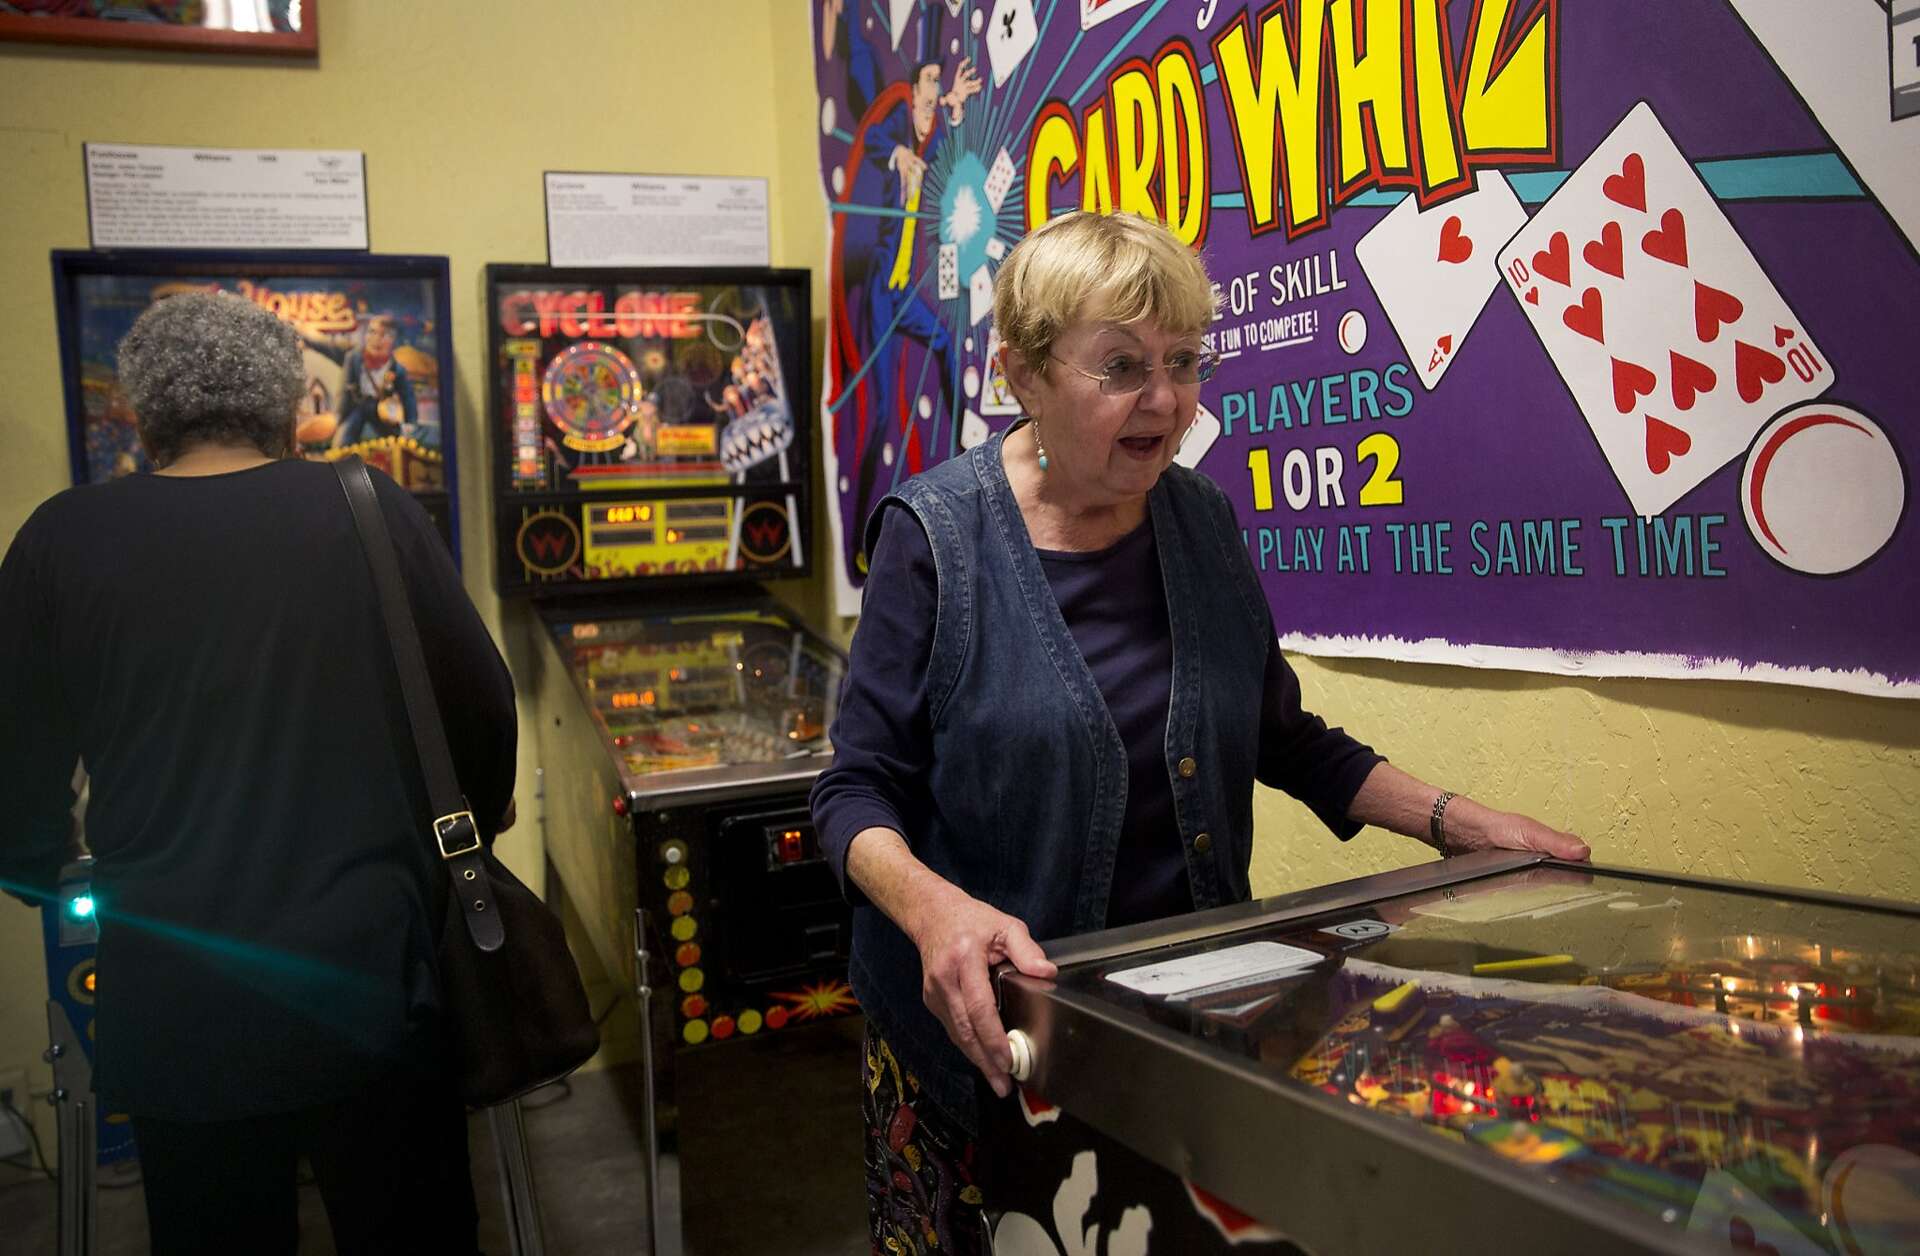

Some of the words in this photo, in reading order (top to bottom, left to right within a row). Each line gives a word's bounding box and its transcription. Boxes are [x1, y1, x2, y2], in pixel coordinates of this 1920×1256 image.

[1025, 38, 1209, 250] CARD
[1210, 0, 1556, 238] WHIZ
[1230, 272, 1259, 316] OF
[1269, 250, 1347, 306] SKILL
[1508, 258, 1529, 288] 10
[501, 290, 703, 339] CYCLONE
[1220, 327, 1241, 352] FUN
[1243, 322, 1258, 347] TO
[1260, 310, 1319, 343] COMPETE!
[1428, 349, 1444, 372] A
[1787, 342, 1822, 383] 10
[1221, 363, 1414, 436] PLAYERS
[1248, 448, 1273, 511] 1
[1282, 447, 1345, 511] OR
[1357, 433, 1403, 506] 2
[1258, 527, 1324, 572] PLAY
[1337, 525, 1371, 572] AT
[1386, 522, 1453, 574] THE
[1470, 519, 1583, 576] SAME
[1602, 515, 1727, 577] TIME
